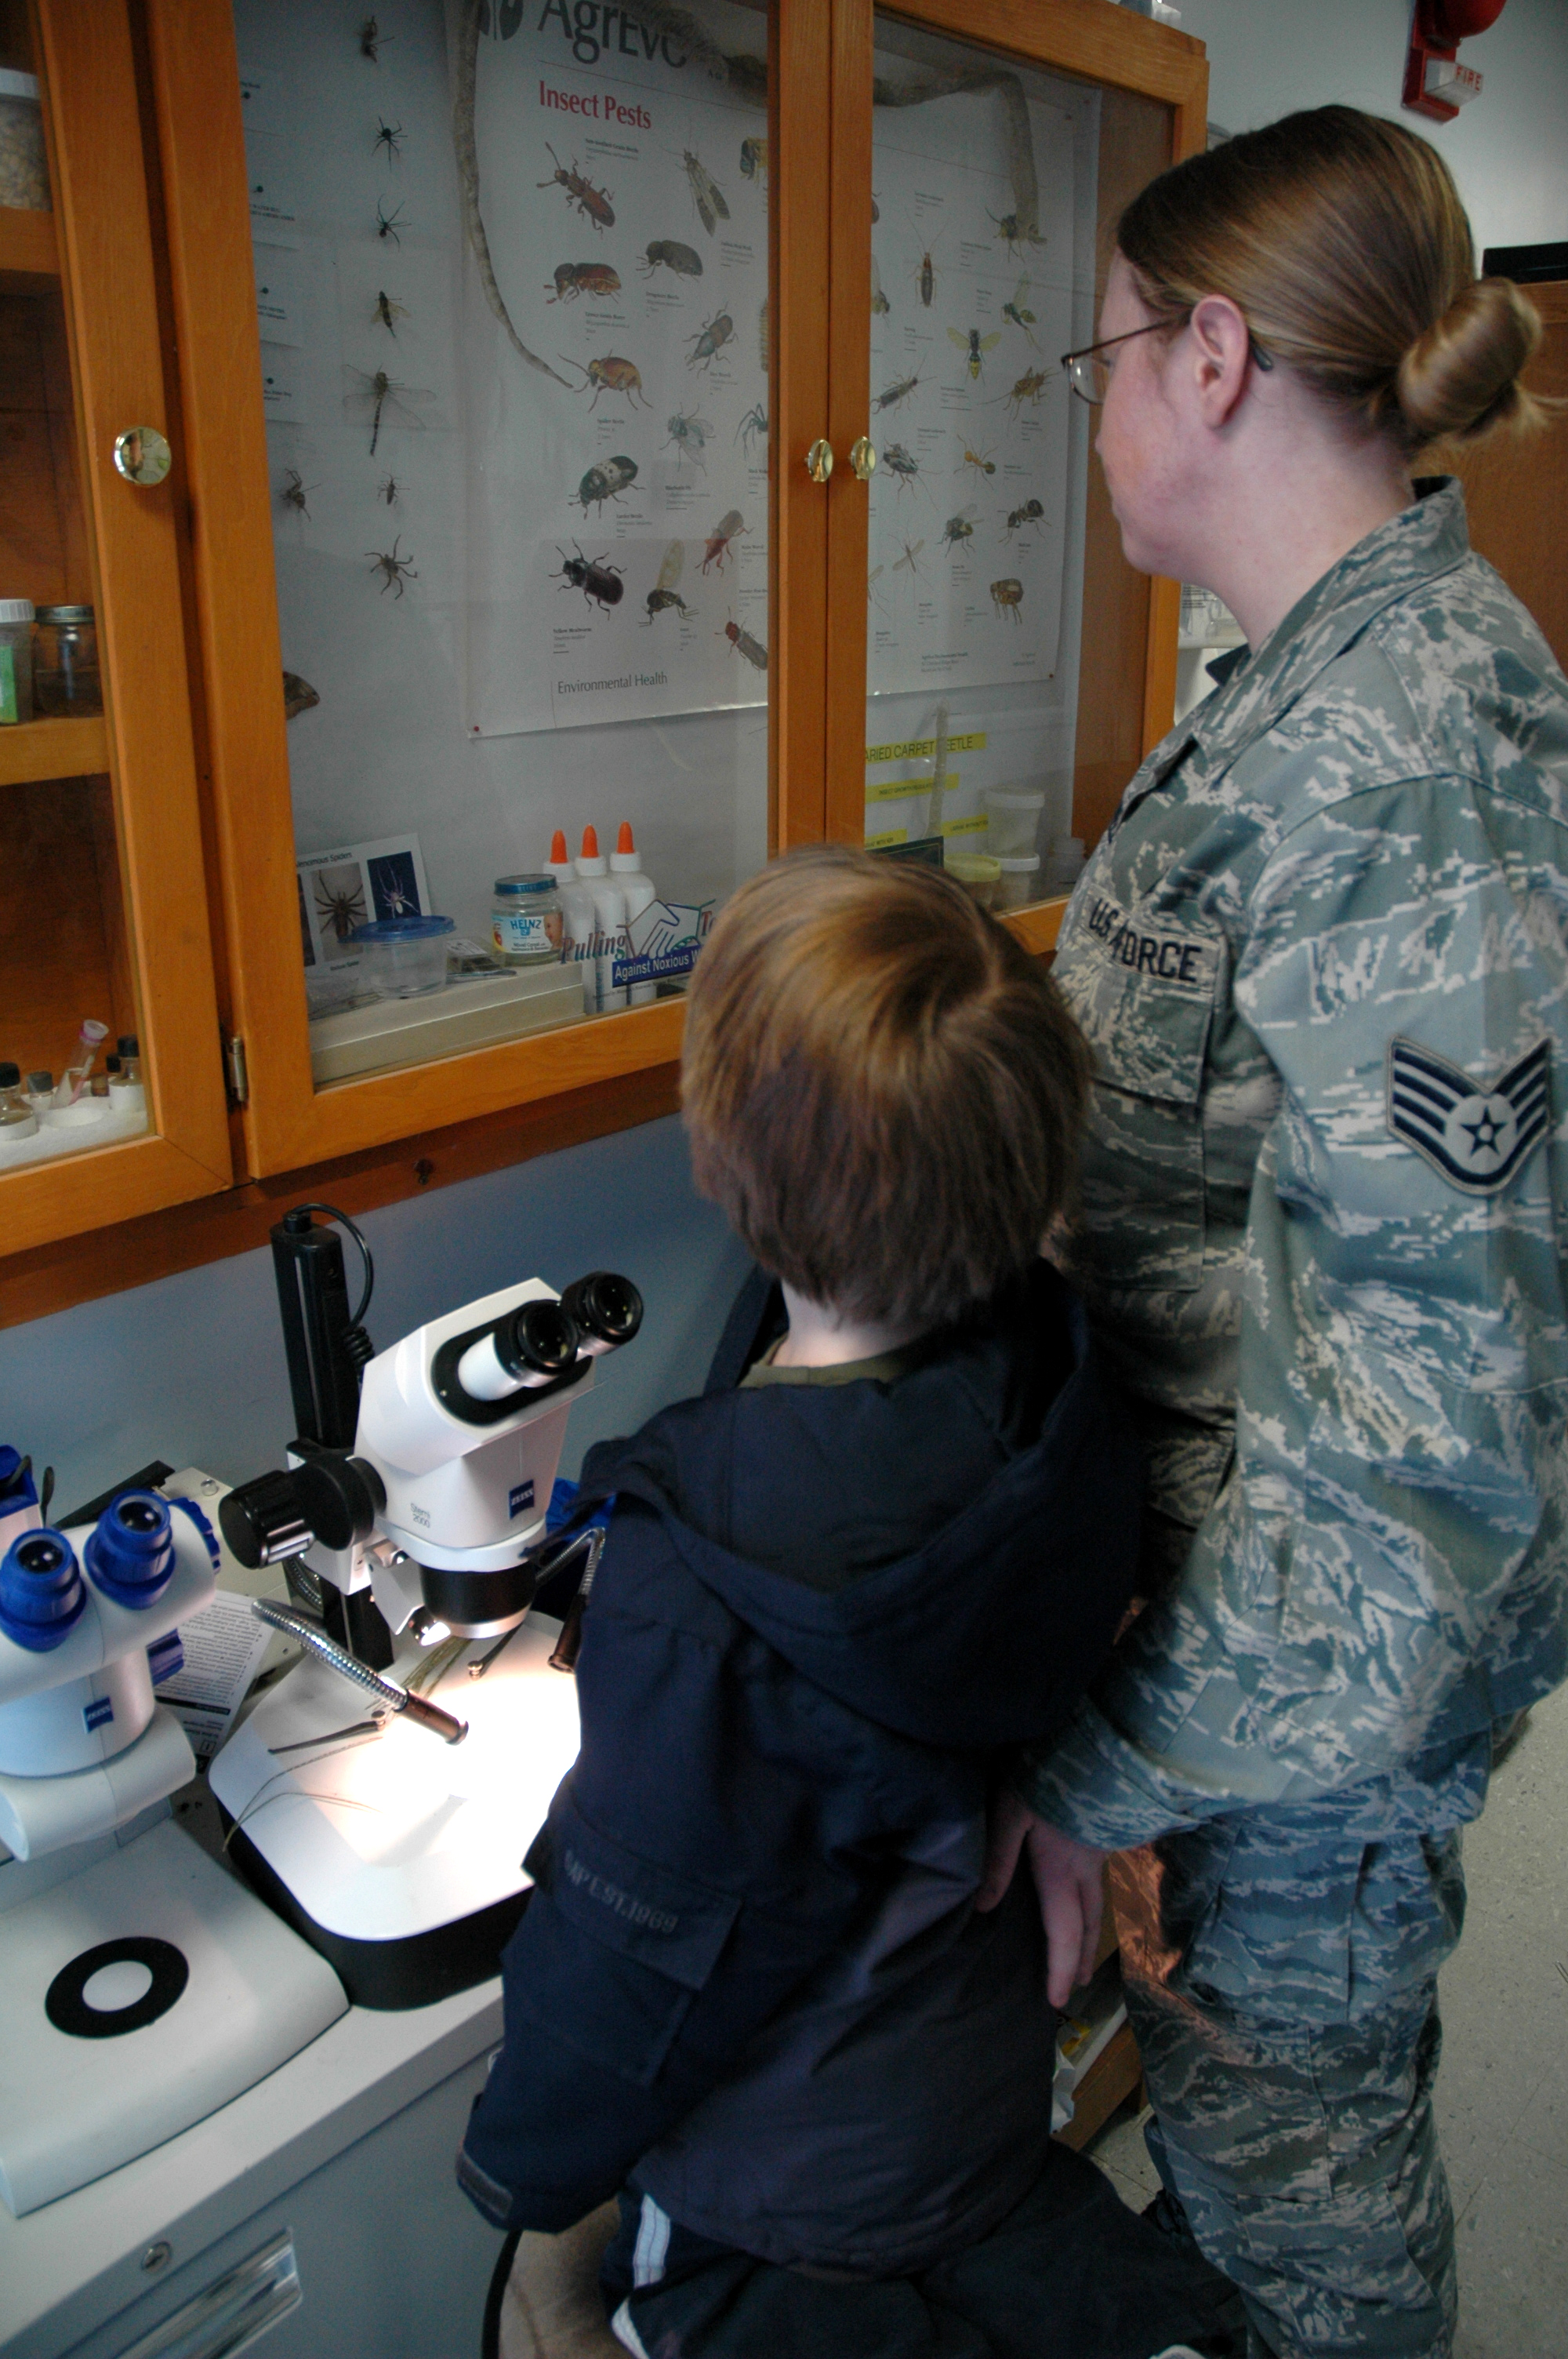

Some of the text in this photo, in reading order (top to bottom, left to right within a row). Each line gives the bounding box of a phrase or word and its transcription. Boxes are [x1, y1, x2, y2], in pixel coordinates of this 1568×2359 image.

[1455, 66, 1482, 91] FIRE
[539, 80, 652, 129] Insect Pests
[557, 671, 668, 694] Environmental Health
[866, 736, 973, 762] ARIED CARPET EETLE
[510, 918, 542, 930] HEINZ
[561, 931, 627, 965] Pulling
[615, 961, 650, 981] Against
[652, 954, 689, 972] Noxious
[510, 1488, 534, 1506] ZEISS
[412, 1513, 430, 1528] 2000
